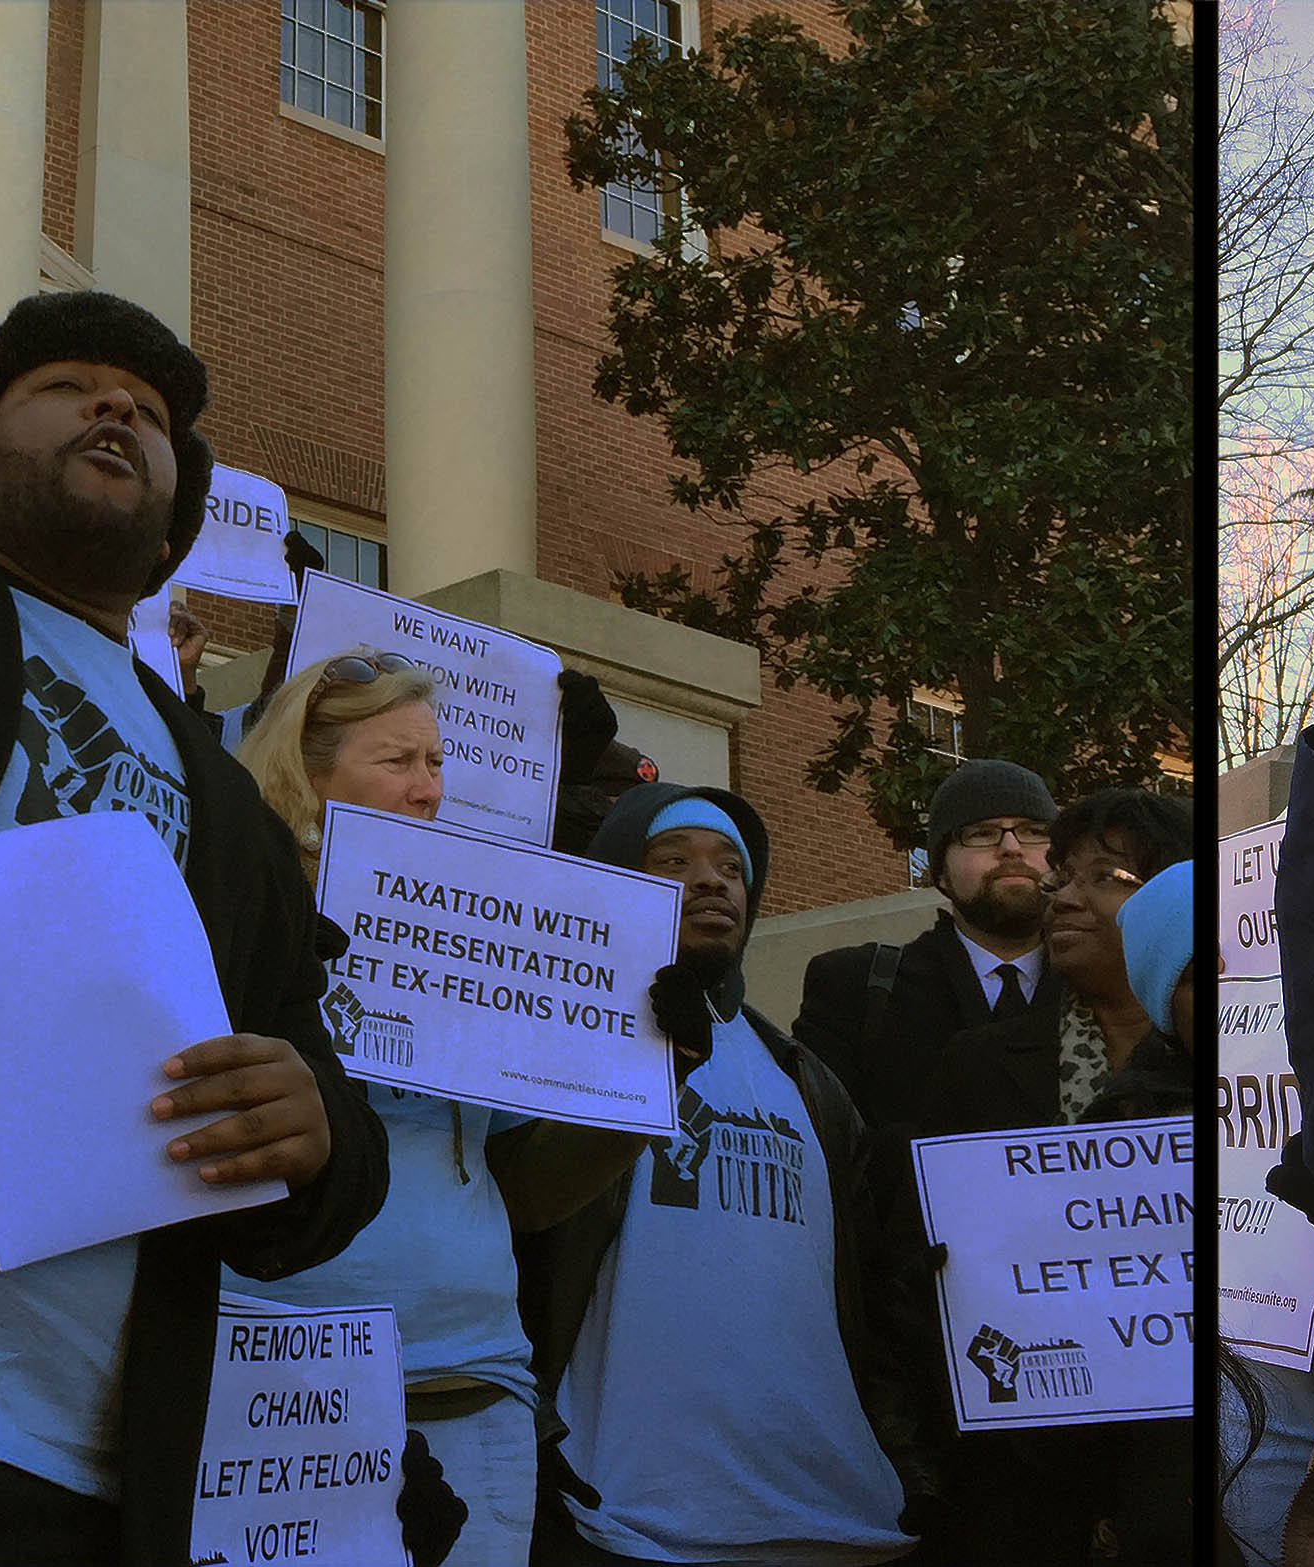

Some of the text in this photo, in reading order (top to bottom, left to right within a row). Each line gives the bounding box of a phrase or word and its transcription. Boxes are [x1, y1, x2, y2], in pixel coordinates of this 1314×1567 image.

[205, 494, 282, 535] RIDE!
[393, 612, 491, 659] WE WANT
[465, 675, 517, 706] WITH
[489, 750, 545, 782] VOTE
[1233, 844, 1264, 886] LET
[373, 869, 611, 948] TAXATION WITH
[352, 911, 616, 993] REPRESENTATION
[329, 952, 637, 1039] LET EX-FELONS VOTE
[363, 1031, 414, 1068] UNITED
[1004, 1131, 1194, 1177] REMOVE
[1012, 1257, 1093, 1295] LET
[1108, 1252, 1171, 1288] EX
[229, 1320, 373, 1362] REMOVE THE
[1025, 1366, 1094, 1399] UNITED
[247, 1388, 349, 1428] CHAINS!
[199, 1448, 392, 1499] LET EX FELONS
[245, 1518, 319, 1563] VOTE!
